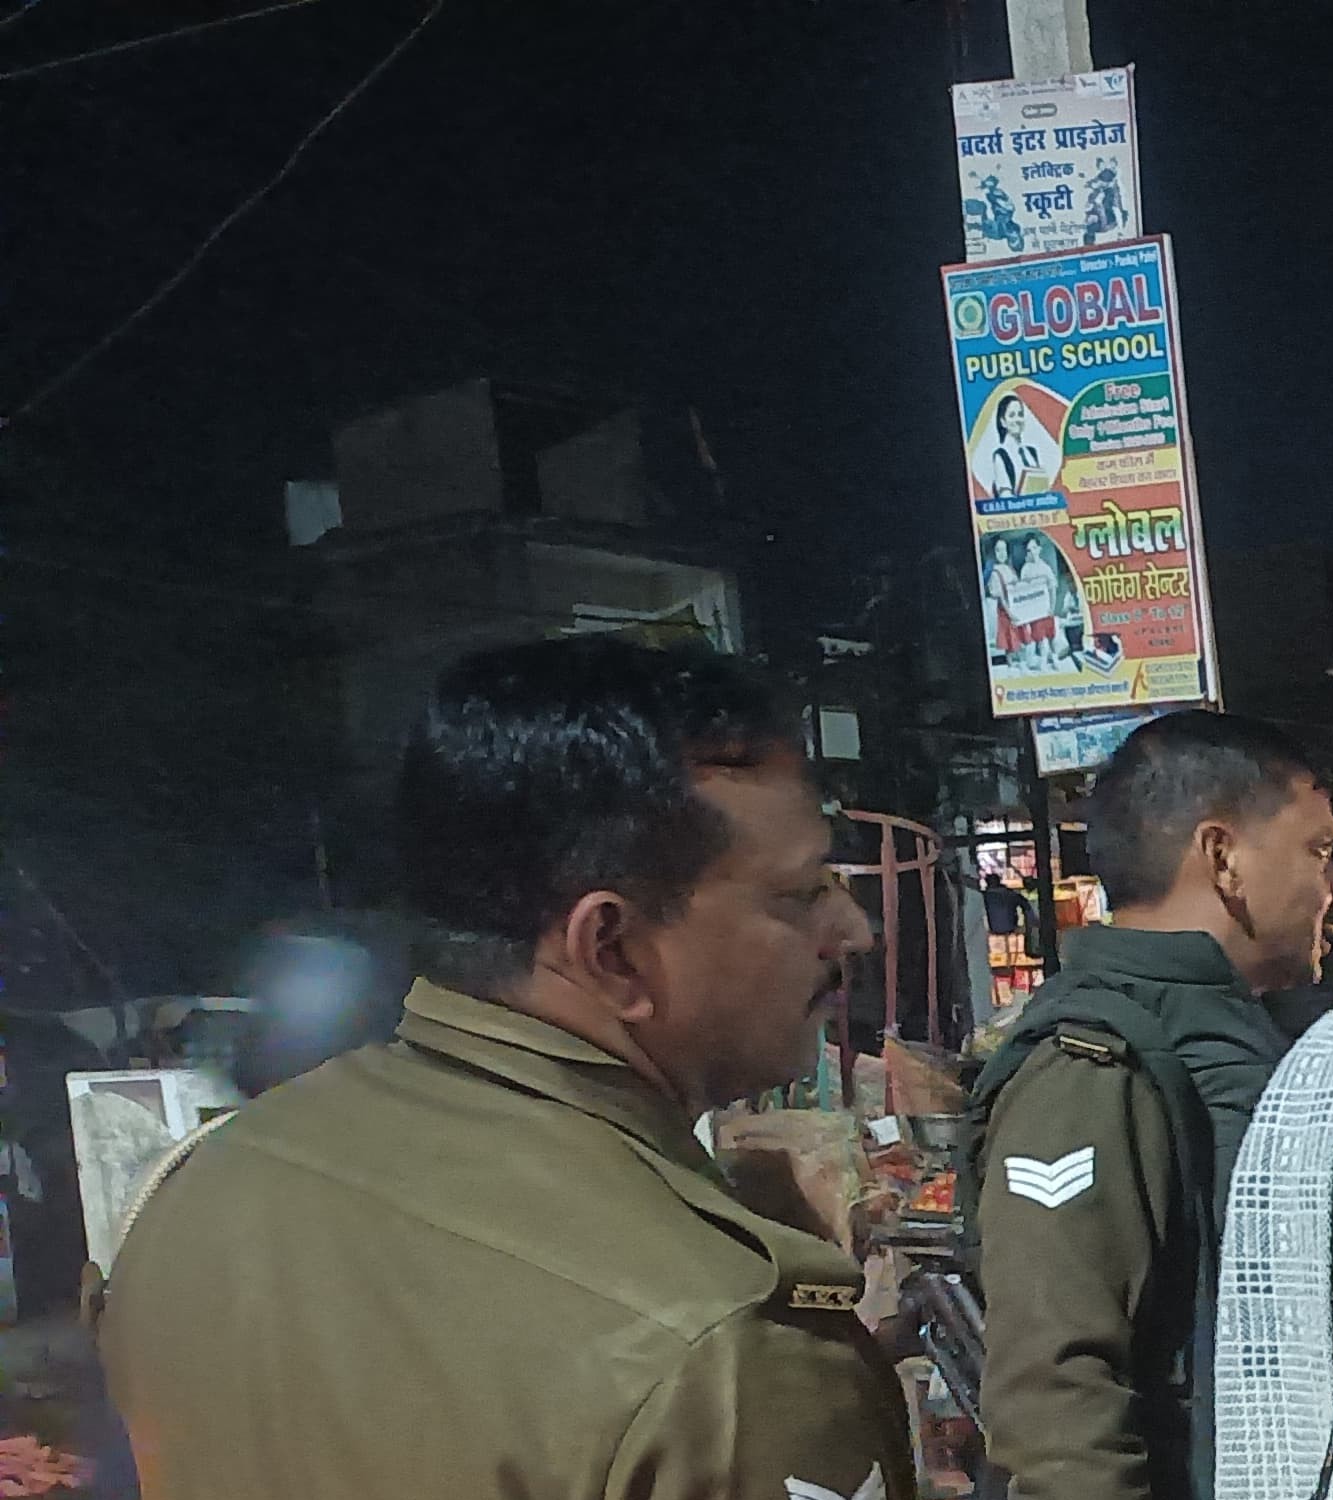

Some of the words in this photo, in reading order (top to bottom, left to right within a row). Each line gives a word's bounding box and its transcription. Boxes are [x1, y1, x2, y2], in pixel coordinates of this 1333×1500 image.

[1054, 118, 1127, 151] प्राइजेज
[1022, 184, 1074, 220] स्कूटी
[989, 275, 1160, 344] GLOBAL
[966, 347, 1054, 382] PUBLIC
[1061, 334, 1164, 366] SCHOOL
[1103, 382, 1141, 402] Free
[1070, 500, 1187, 559] ग्लोबल
[1083, 562, 1143, 606] कोचिंग
[1144, 559, 1191, 600] सेन्टर
